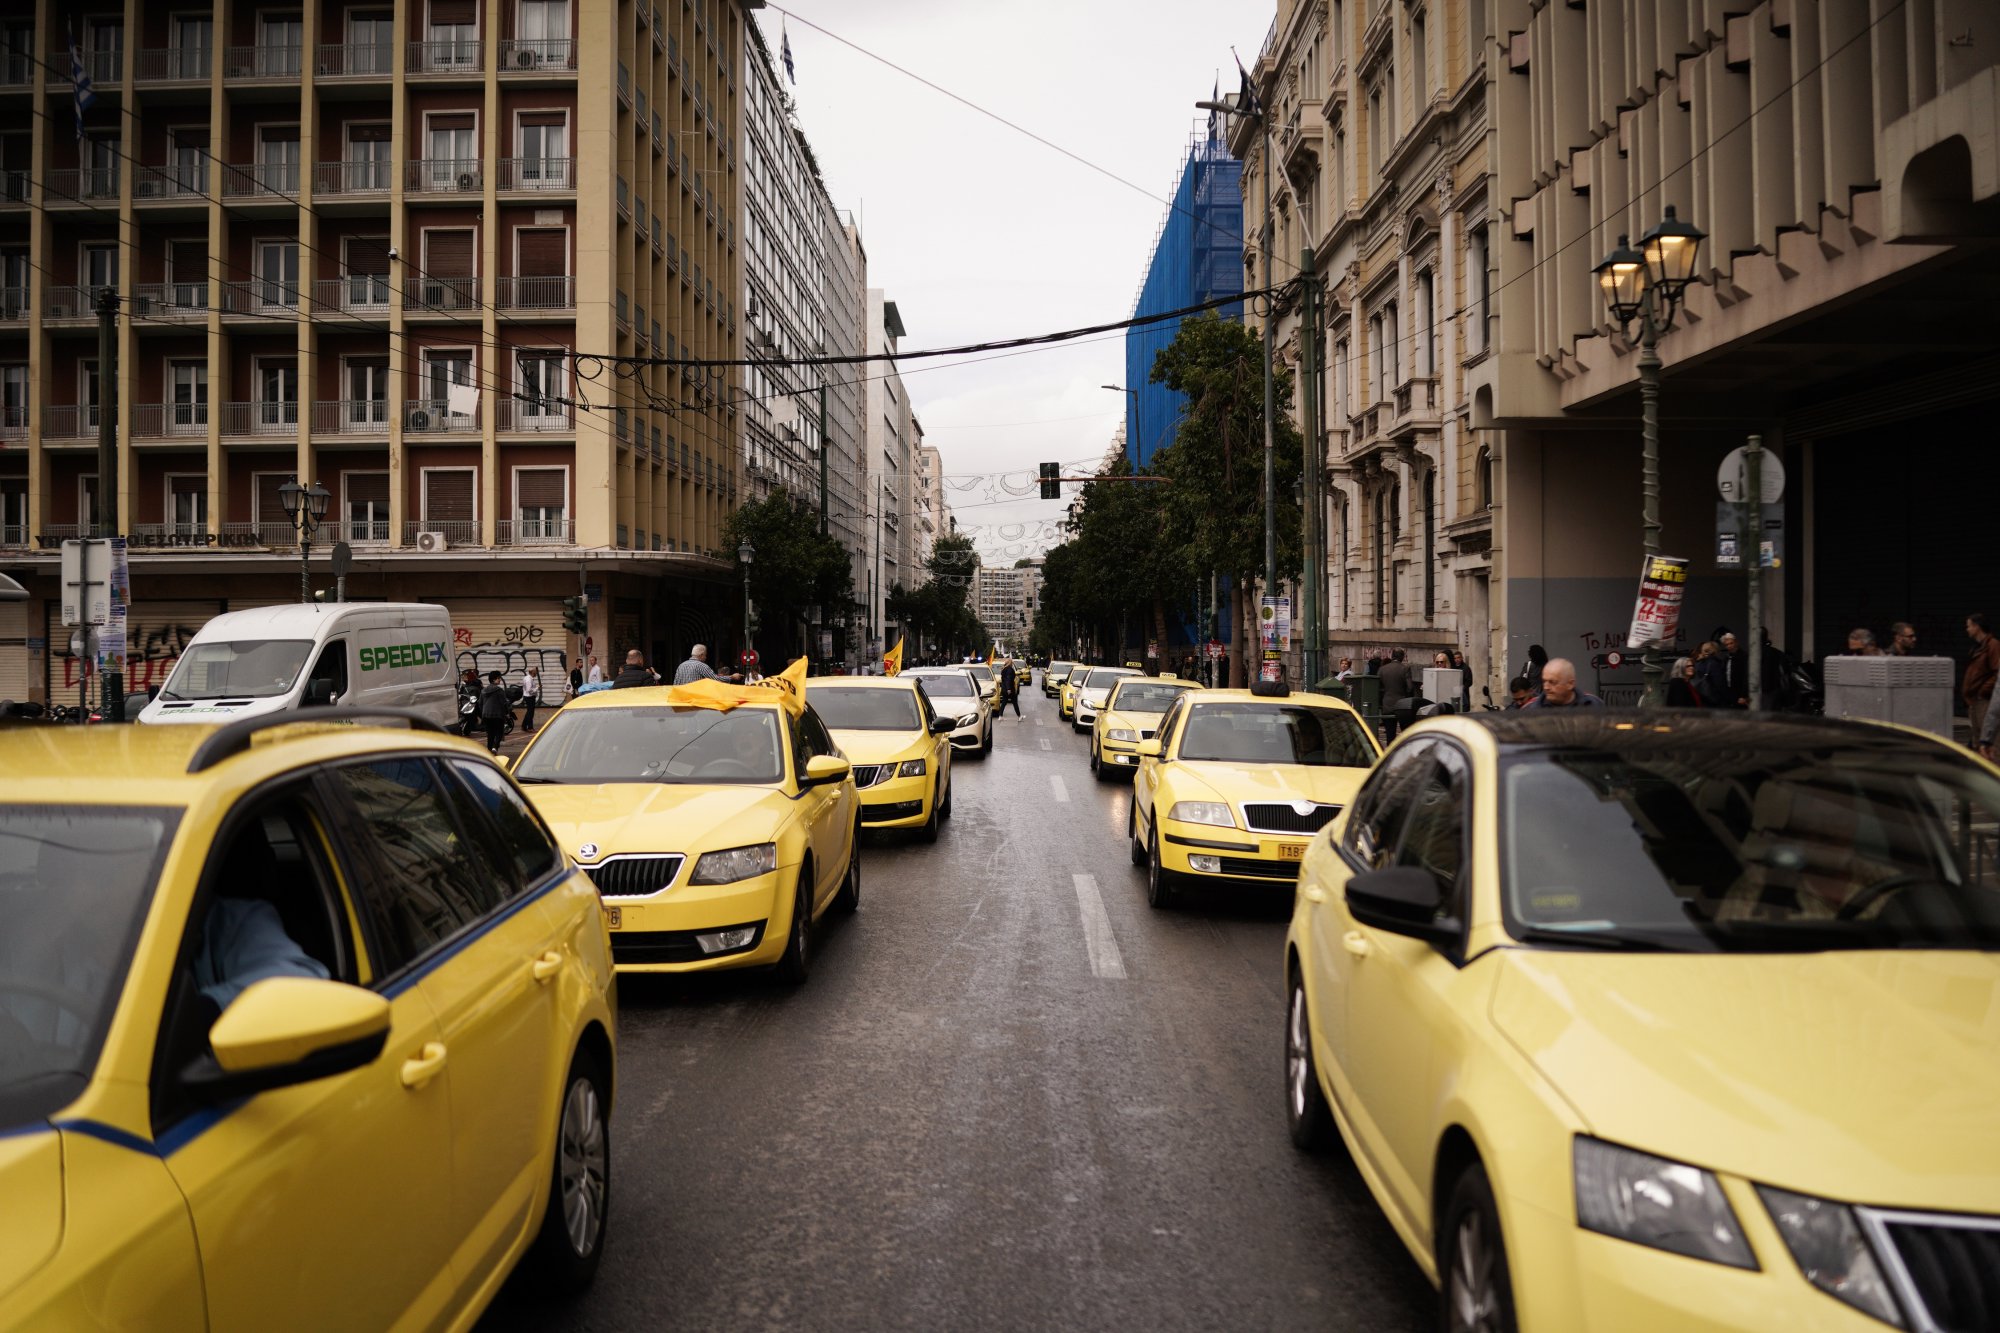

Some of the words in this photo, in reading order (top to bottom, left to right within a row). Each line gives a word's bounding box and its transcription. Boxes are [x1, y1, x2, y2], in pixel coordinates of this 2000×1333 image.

[143, 533, 264, 547] ΕΣΩΤΕΡΙΚΩΝ
[1640, 598, 1656, 615] 22
[360, 641, 448, 671] SPEEDEX
[157, 707, 239, 716] SPEEDEX
